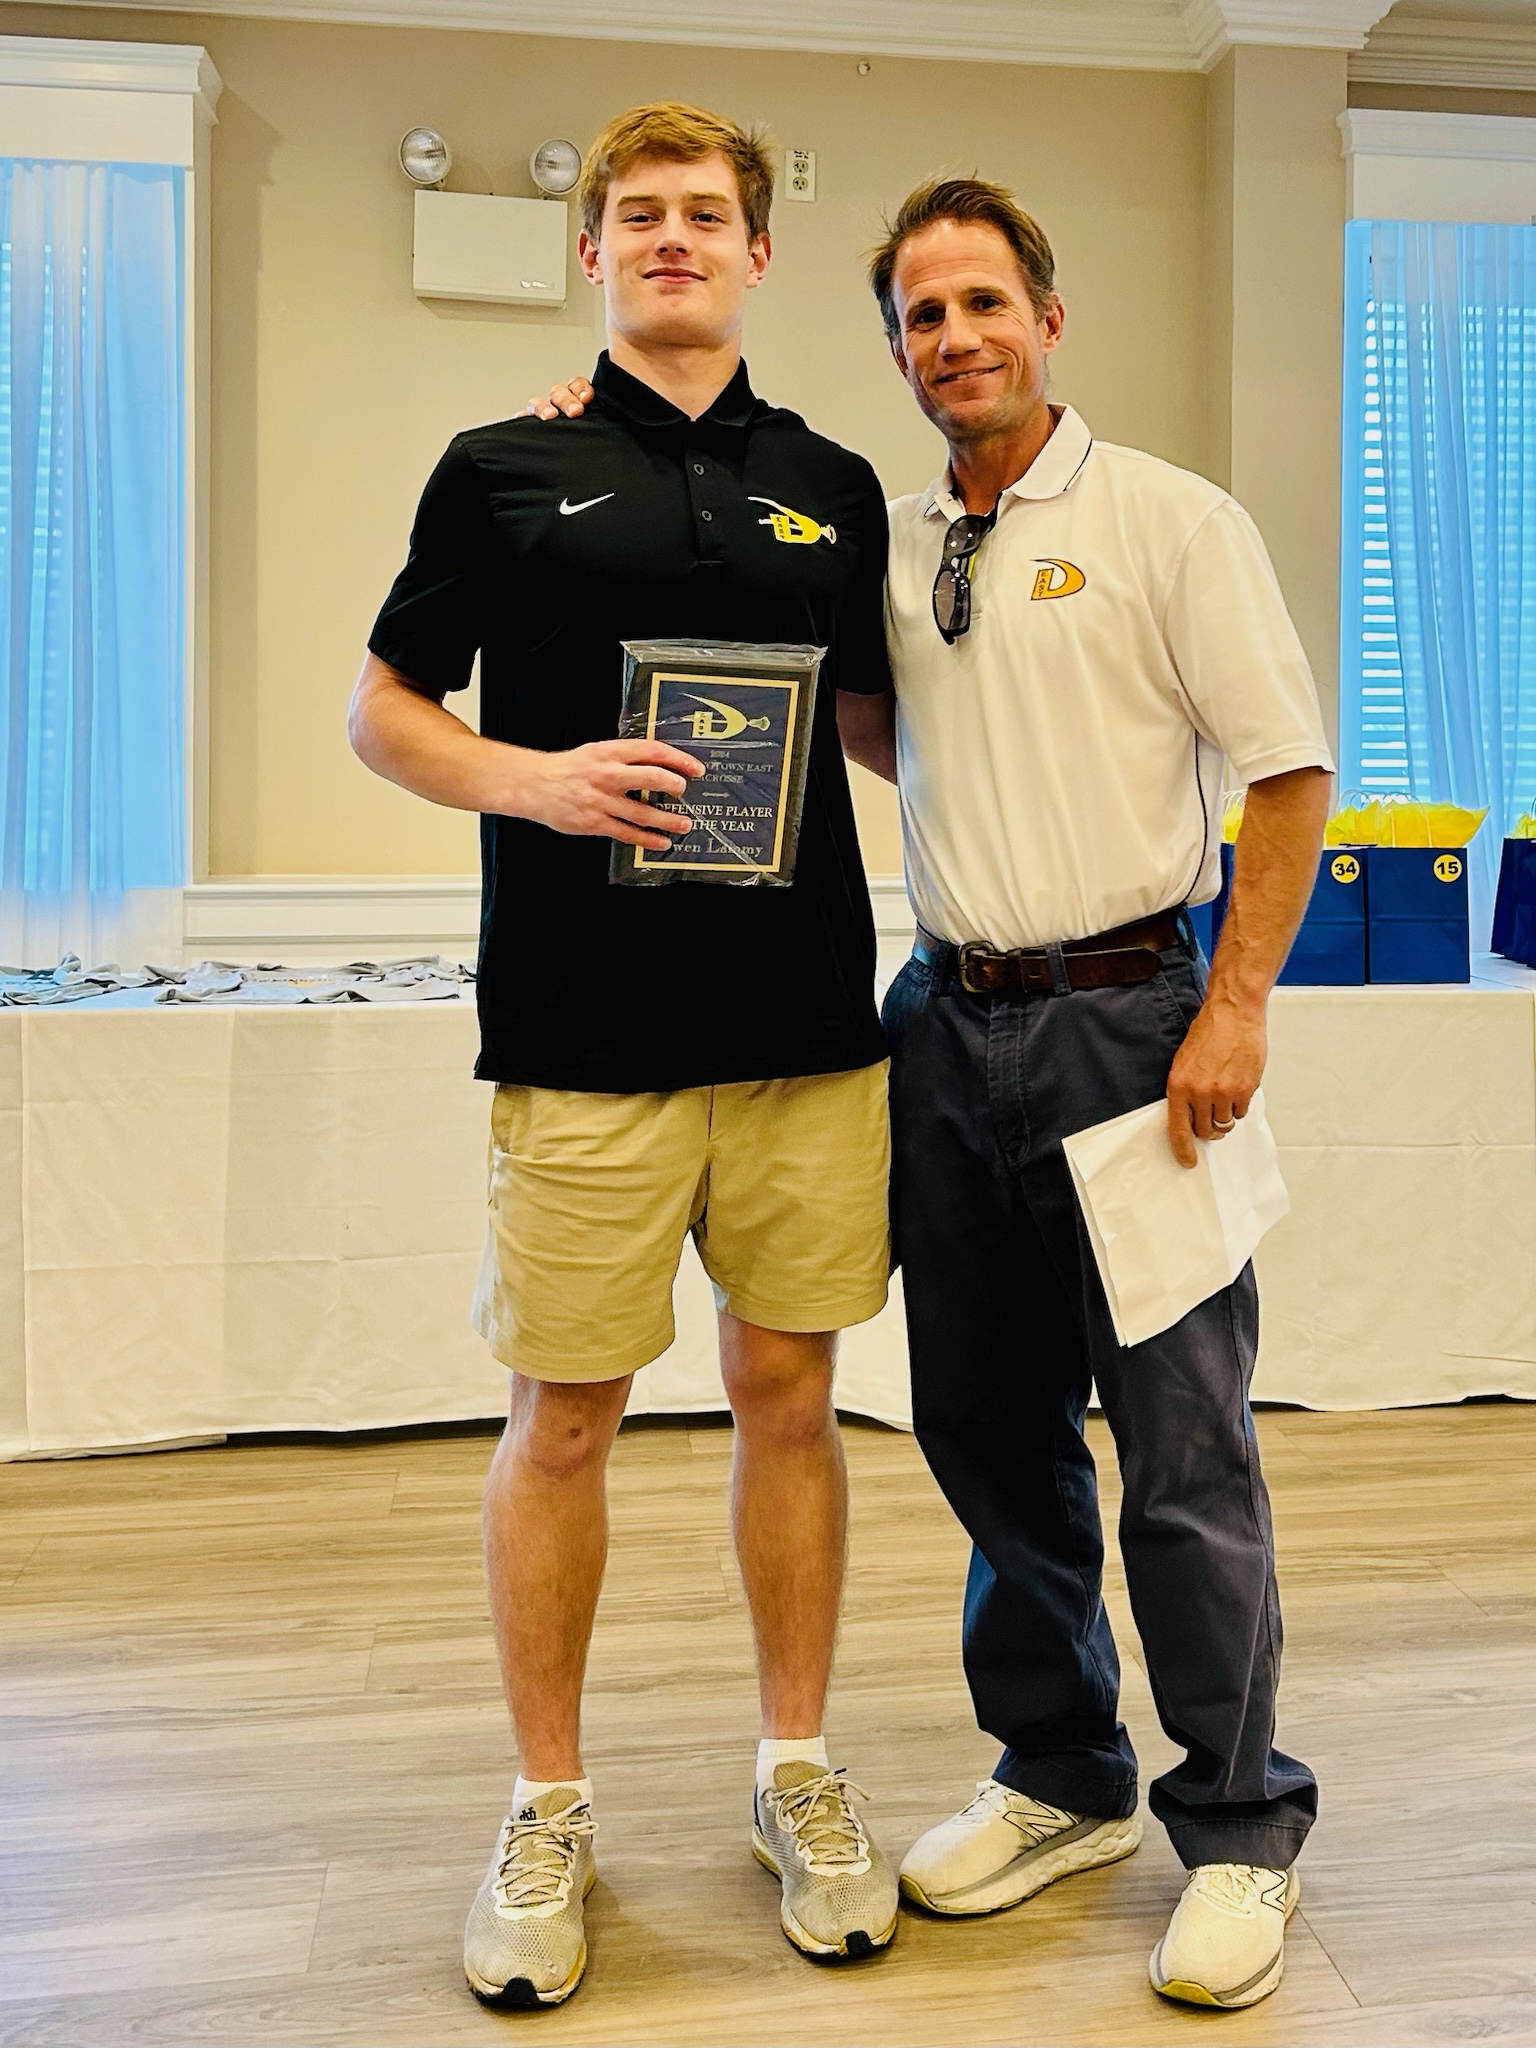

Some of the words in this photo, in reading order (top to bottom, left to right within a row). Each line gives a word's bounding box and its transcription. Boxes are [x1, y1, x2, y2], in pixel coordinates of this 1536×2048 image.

[1029, 558, 1086, 600] D
[1038, 571, 1047, 597] EAST
[746, 763, 774, 773] EAST
[725, 806, 773, 818] PLAYER
[692, 819, 718, 831] THE
[720, 820, 755, 832] YEAR
[673, 843, 701, 853] wen
[1334, 861, 1357, 876] 34
[1437, 861, 1459, 875] 15
